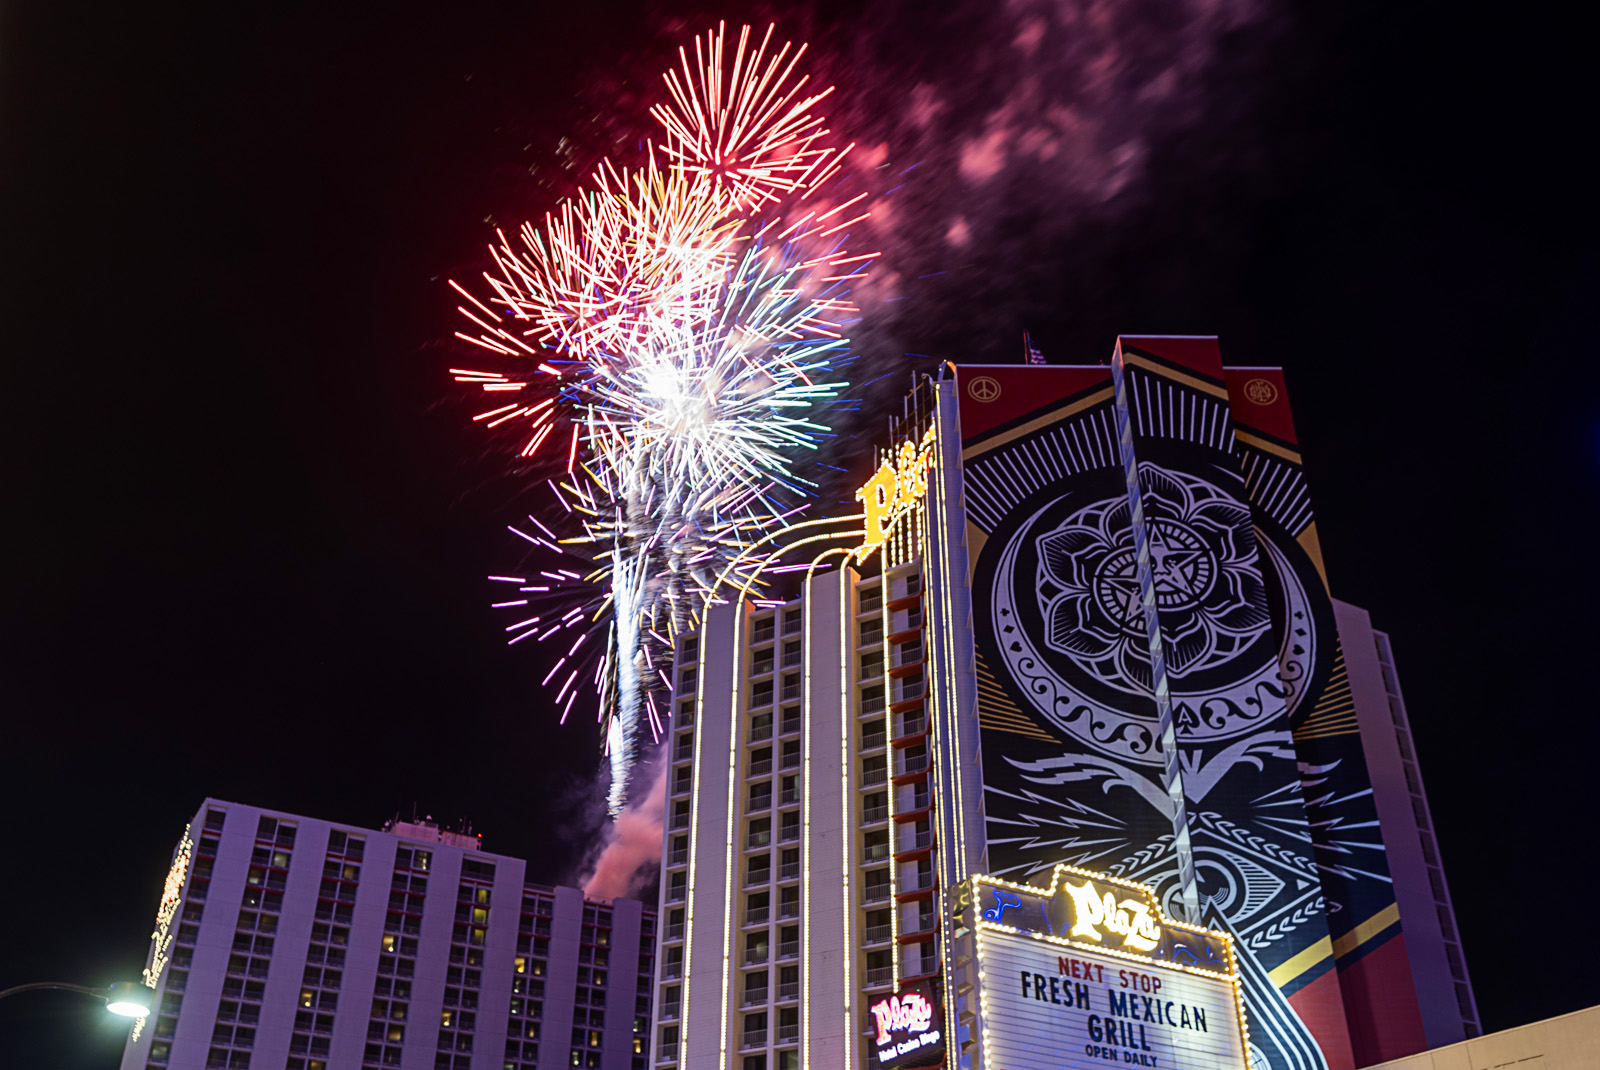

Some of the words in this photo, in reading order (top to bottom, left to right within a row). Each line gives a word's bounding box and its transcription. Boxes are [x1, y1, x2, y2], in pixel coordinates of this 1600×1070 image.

[1178, 706, 1193, 724] A
[1064, 880, 1161, 951] Plaza
[1058, 956, 1104, 983] NEXT
[1119, 969, 1162, 994] STOP
[871, 993, 932, 1046] Plaza
[1021, 971, 1091, 1011] FRESH
[1108, 989, 1208, 1032] MEXICAN
[1088, 1014, 1152, 1051] GRILL
[1085, 1044, 1118, 1061] OPEN
[1123, 1051, 1158, 1068] DAILY
